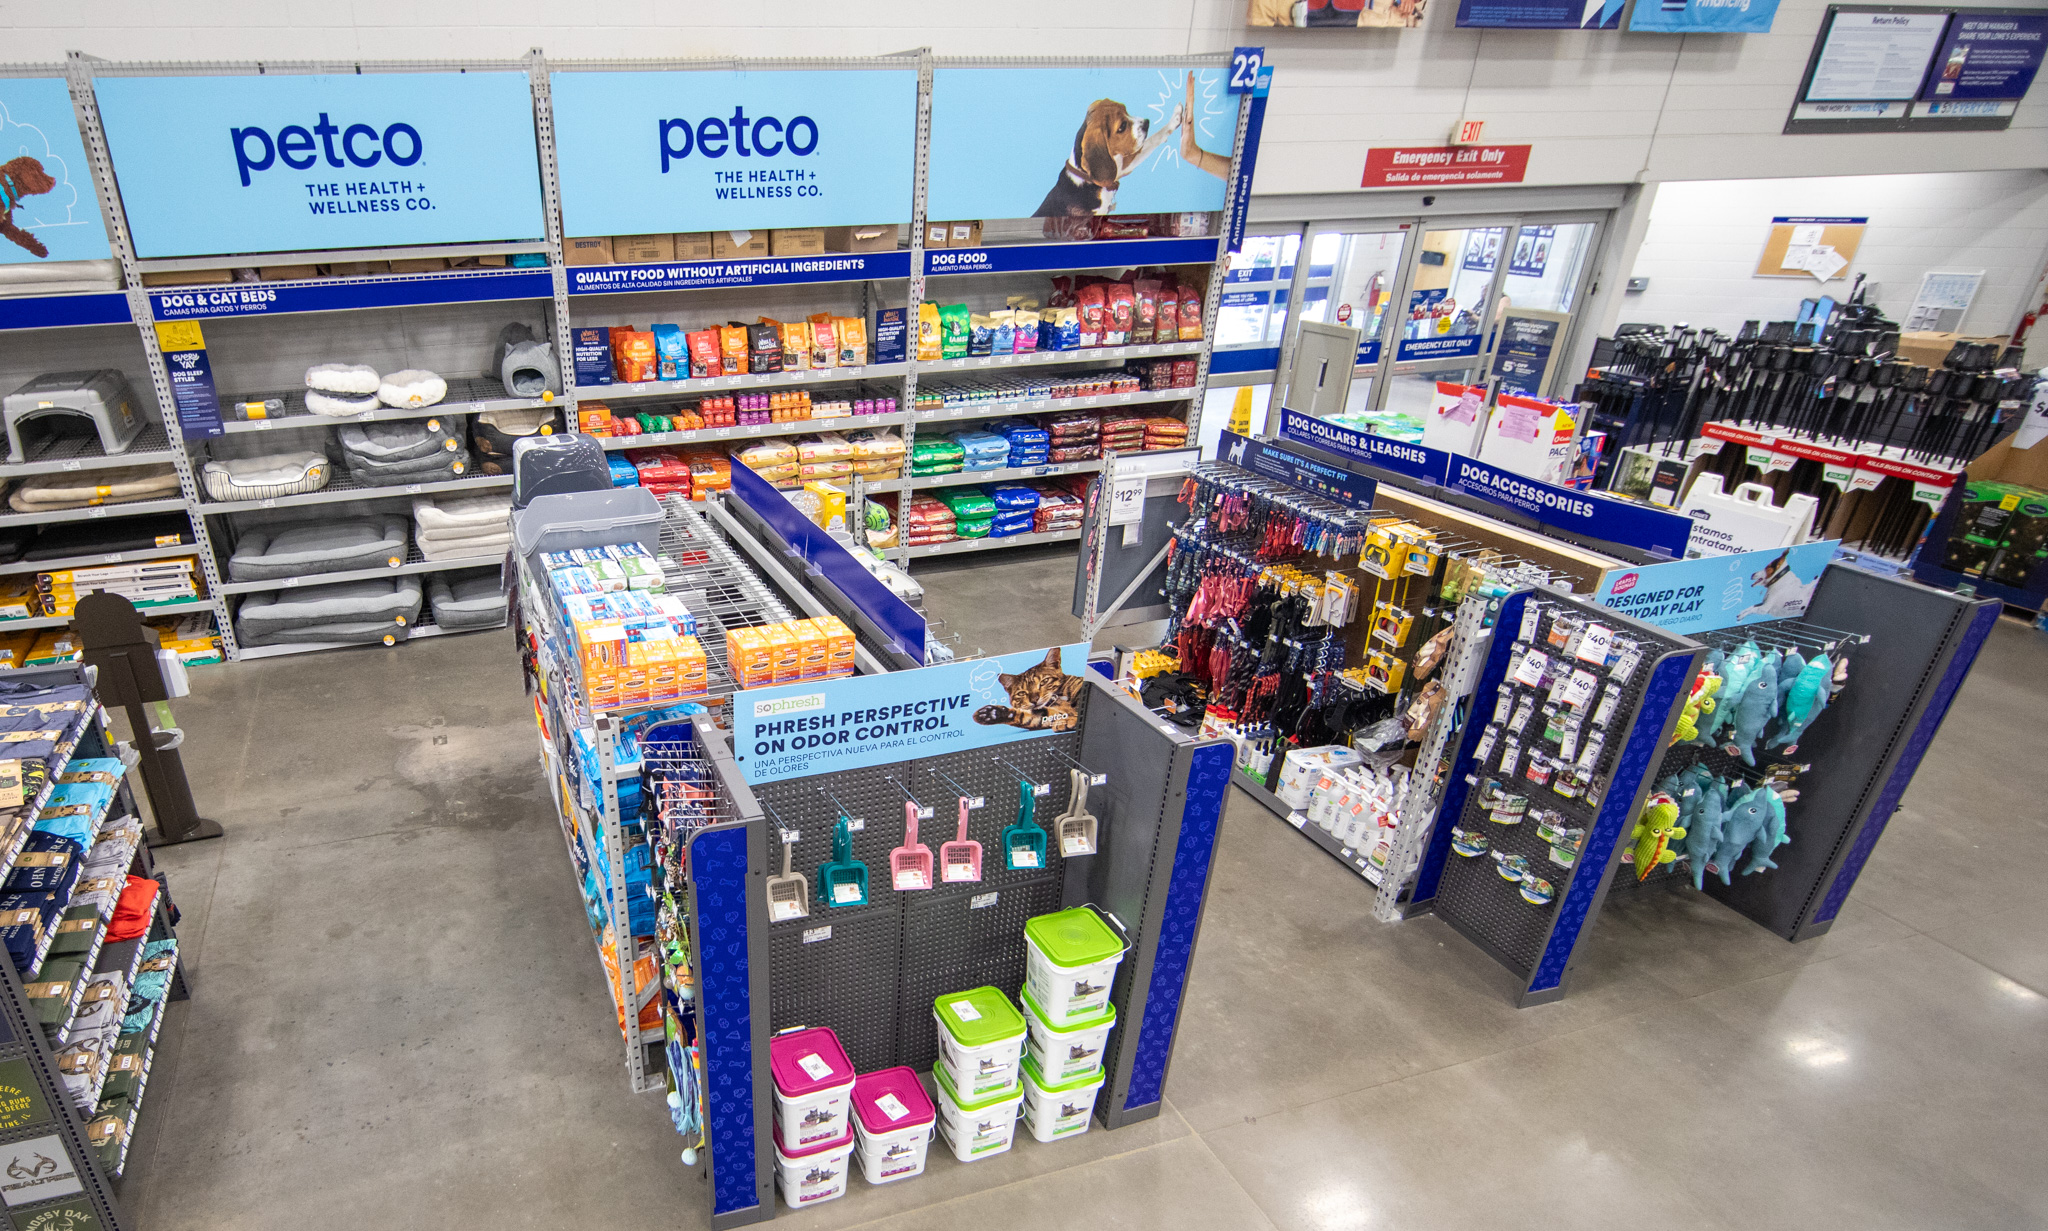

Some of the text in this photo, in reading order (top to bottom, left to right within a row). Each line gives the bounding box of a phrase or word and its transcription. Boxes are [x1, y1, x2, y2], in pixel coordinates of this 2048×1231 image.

[1872, 16, 1910, 26] Return Policy
[1230, 54, 1261, 88] 23
[658, 106, 819, 174] petco
[1460, 122, 1484, 142] EXIT
[230, 112, 423, 187] petco
[1392, 149, 1505, 166] Emergency Exit Only
[715, 171, 743, 184] THE
[748, 170, 806, 182] HEALTH
[1385, 171, 1503, 182] Salida de emergencia solamente
[306, 183, 340, 198] THE
[346, 181, 412, 196] HEALTH
[716, 184, 823, 200] WELLNESS CO.
[309, 198, 436, 215] WELLNESS CO.
[1232, 175, 1248, 246] Animal Feed
[932, 252, 988, 265] DOG FOOD
[576, 260, 864, 284] QUALITY FOOD WITHOUT ARTIFICIAL INGREDIENTS
[162, 290, 276, 308] DOG & CAT BEDS
[164, 308, 190, 316] CAMAS
[210, 305, 234, 314] GATOS
[240, 303, 267, 312] PERROS
[1405, 338, 1472, 351] EMERGENCY EXIT ONLY
[1288, 414, 1426, 464] DOG COLLARS & LEASHES
[1288, 426, 1312, 440] COLLARES
[1314, 436, 1337, 448] CORREAS
[1336, 444, 1351, 452] PARA
[1350, 448, 1372, 459] PERROS
[1722, 430, 1739, 438] BUGS
[1746, 435, 1762, 443] CONTA
[1781, 444, 1796, 452] KILLS
[1796, 446, 1814, 455] BUGS
[1824, 453, 1848, 462] CONTACT
[1262, 447, 1280, 458] MAKE
[1279, 452, 1294, 464] SURE
[1310, 464, 1336, 479] PERFECT
[1336, 472, 1348, 482] FIT
[1772, 458, 1794, 467] pic
[1866, 460, 1942, 481] KILLS BUGS ON CONTACT
[1828, 472, 1848, 480] SOLAR
[1854, 477, 1877, 487] pic
[1458, 478, 1540, 512] ACCESORIOS PARA PERROS
[1460, 463, 1594, 518] DOG ACCESSORIES
[1918, 492, 1940, 500] SOLAR
[1692, 525, 1734, 541] stamos
[1606, 586, 1704, 608] DESIGNED FOR
[1784, 600, 1802, 609] petco
[1669, 599, 1705, 614] PLAY
[1656, 614, 1702, 626] JUEGO DIARIO
[756, 696, 821, 714] sophresh
[754, 694, 970, 738] PHRESH PERSPECTIVE
[1041, 712, 1068, 725] petco
[754, 714, 950, 756] ON ODOR CONTROL
[754, 730, 965, 768] UNA PERSPECTIVA NUEVA PARA EL CONTROL
[754, 762, 809, 778] DE OLORES
[5, 1102, 30, 1112] DEERE
[9, 1096, 31, 1106] RUNS
[26, 1209, 92, 1231] MOSSY OAK
